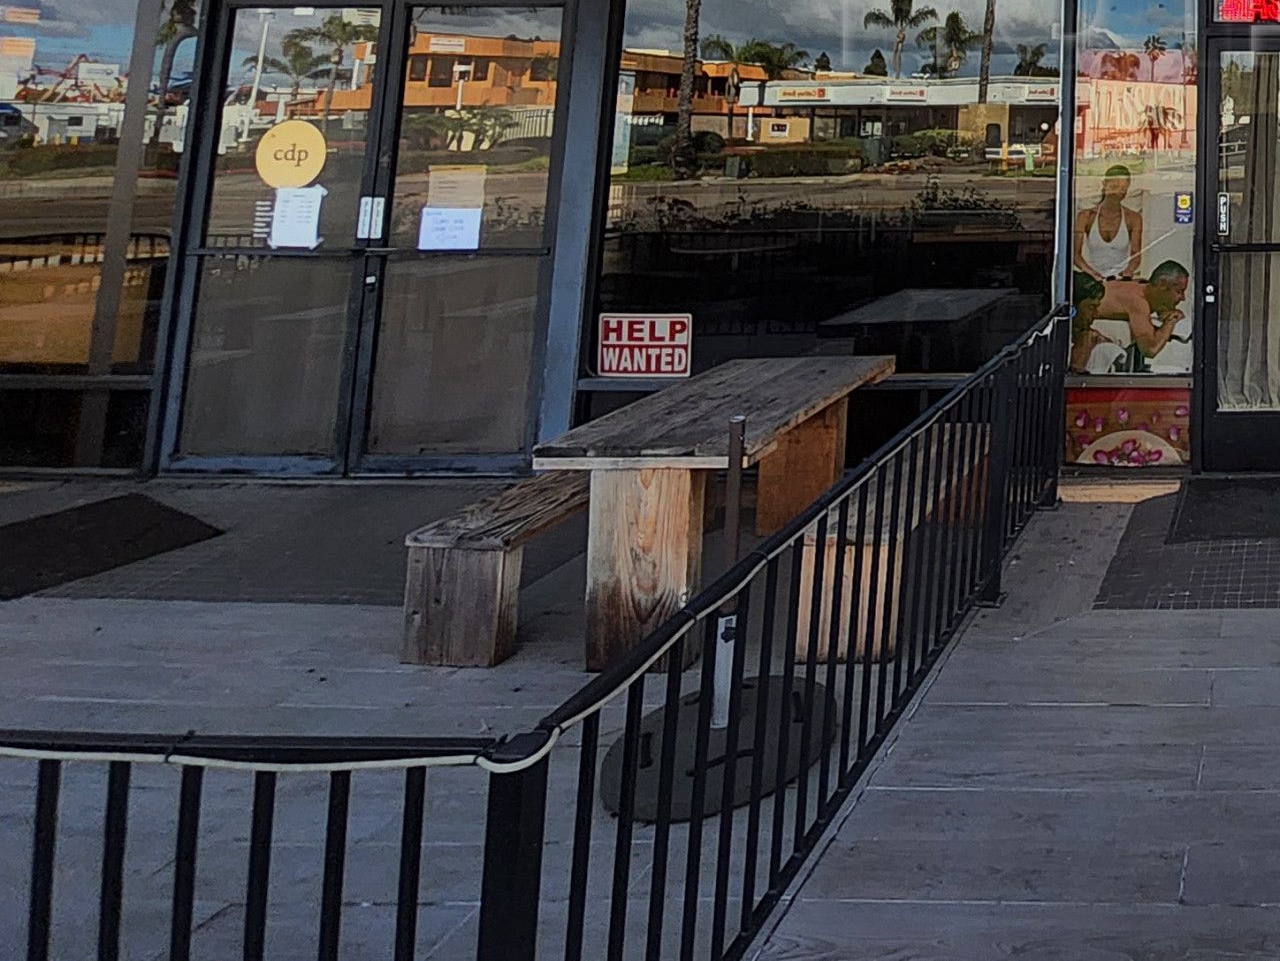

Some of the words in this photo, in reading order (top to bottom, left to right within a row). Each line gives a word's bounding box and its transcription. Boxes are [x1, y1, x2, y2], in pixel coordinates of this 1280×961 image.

[273, 143, 309, 167] cdp
[1219, 195, 1228, 232] PUSH
[603, 319, 688, 342] HELP
[602, 346, 687, 372] WANTED
